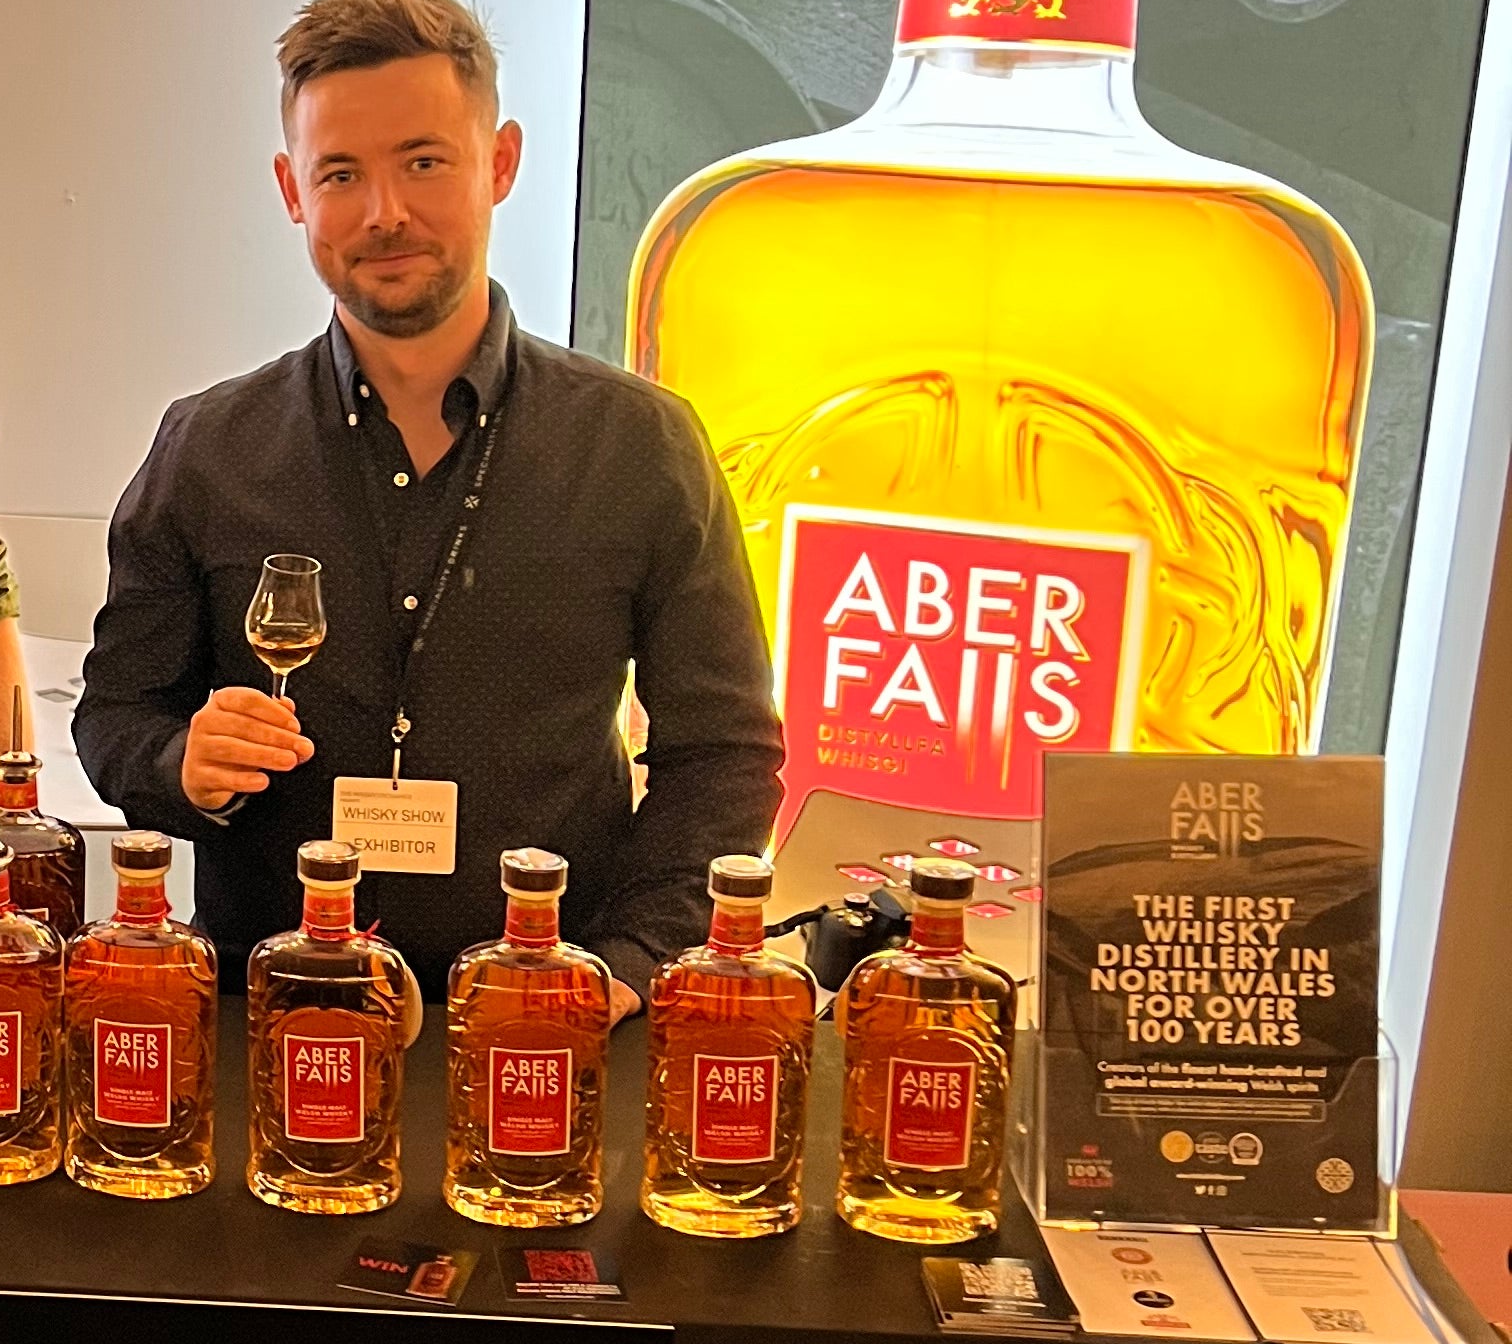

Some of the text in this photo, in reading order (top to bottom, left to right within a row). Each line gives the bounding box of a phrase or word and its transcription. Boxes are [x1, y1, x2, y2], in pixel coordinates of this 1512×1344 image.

[823, 552, 1091, 662] ABER
[818, 724, 944, 755] DISTYLLFA
[818, 747, 907, 773] WHISGI
[1170, 781, 1264, 811] ABER
[342, 806, 446, 824] WHISKY SHOW
[354, 837, 436, 854] EXHIBITOR
[1133, 895, 1295, 920] THE FIRST
[1142, 920, 1285, 945] WHISKY
[1098, 943, 1329, 972] DISTILLERY IN
[1090, 968, 1336, 997] NORTH WALES
[1127, 995, 1298, 1021] FOR OVER
[104, 1031, 159, 1050] ABER
[1126, 1019, 1302, 1047] 100 YEARS
[294, 1046, 352, 1065] ABER
[501, 1059, 560, 1077] ABER
[705, 1066, 765, 1084] ABER
[900, 1070, 962, 1090] ABER
[358, 1257, 409, 1274] WIN
